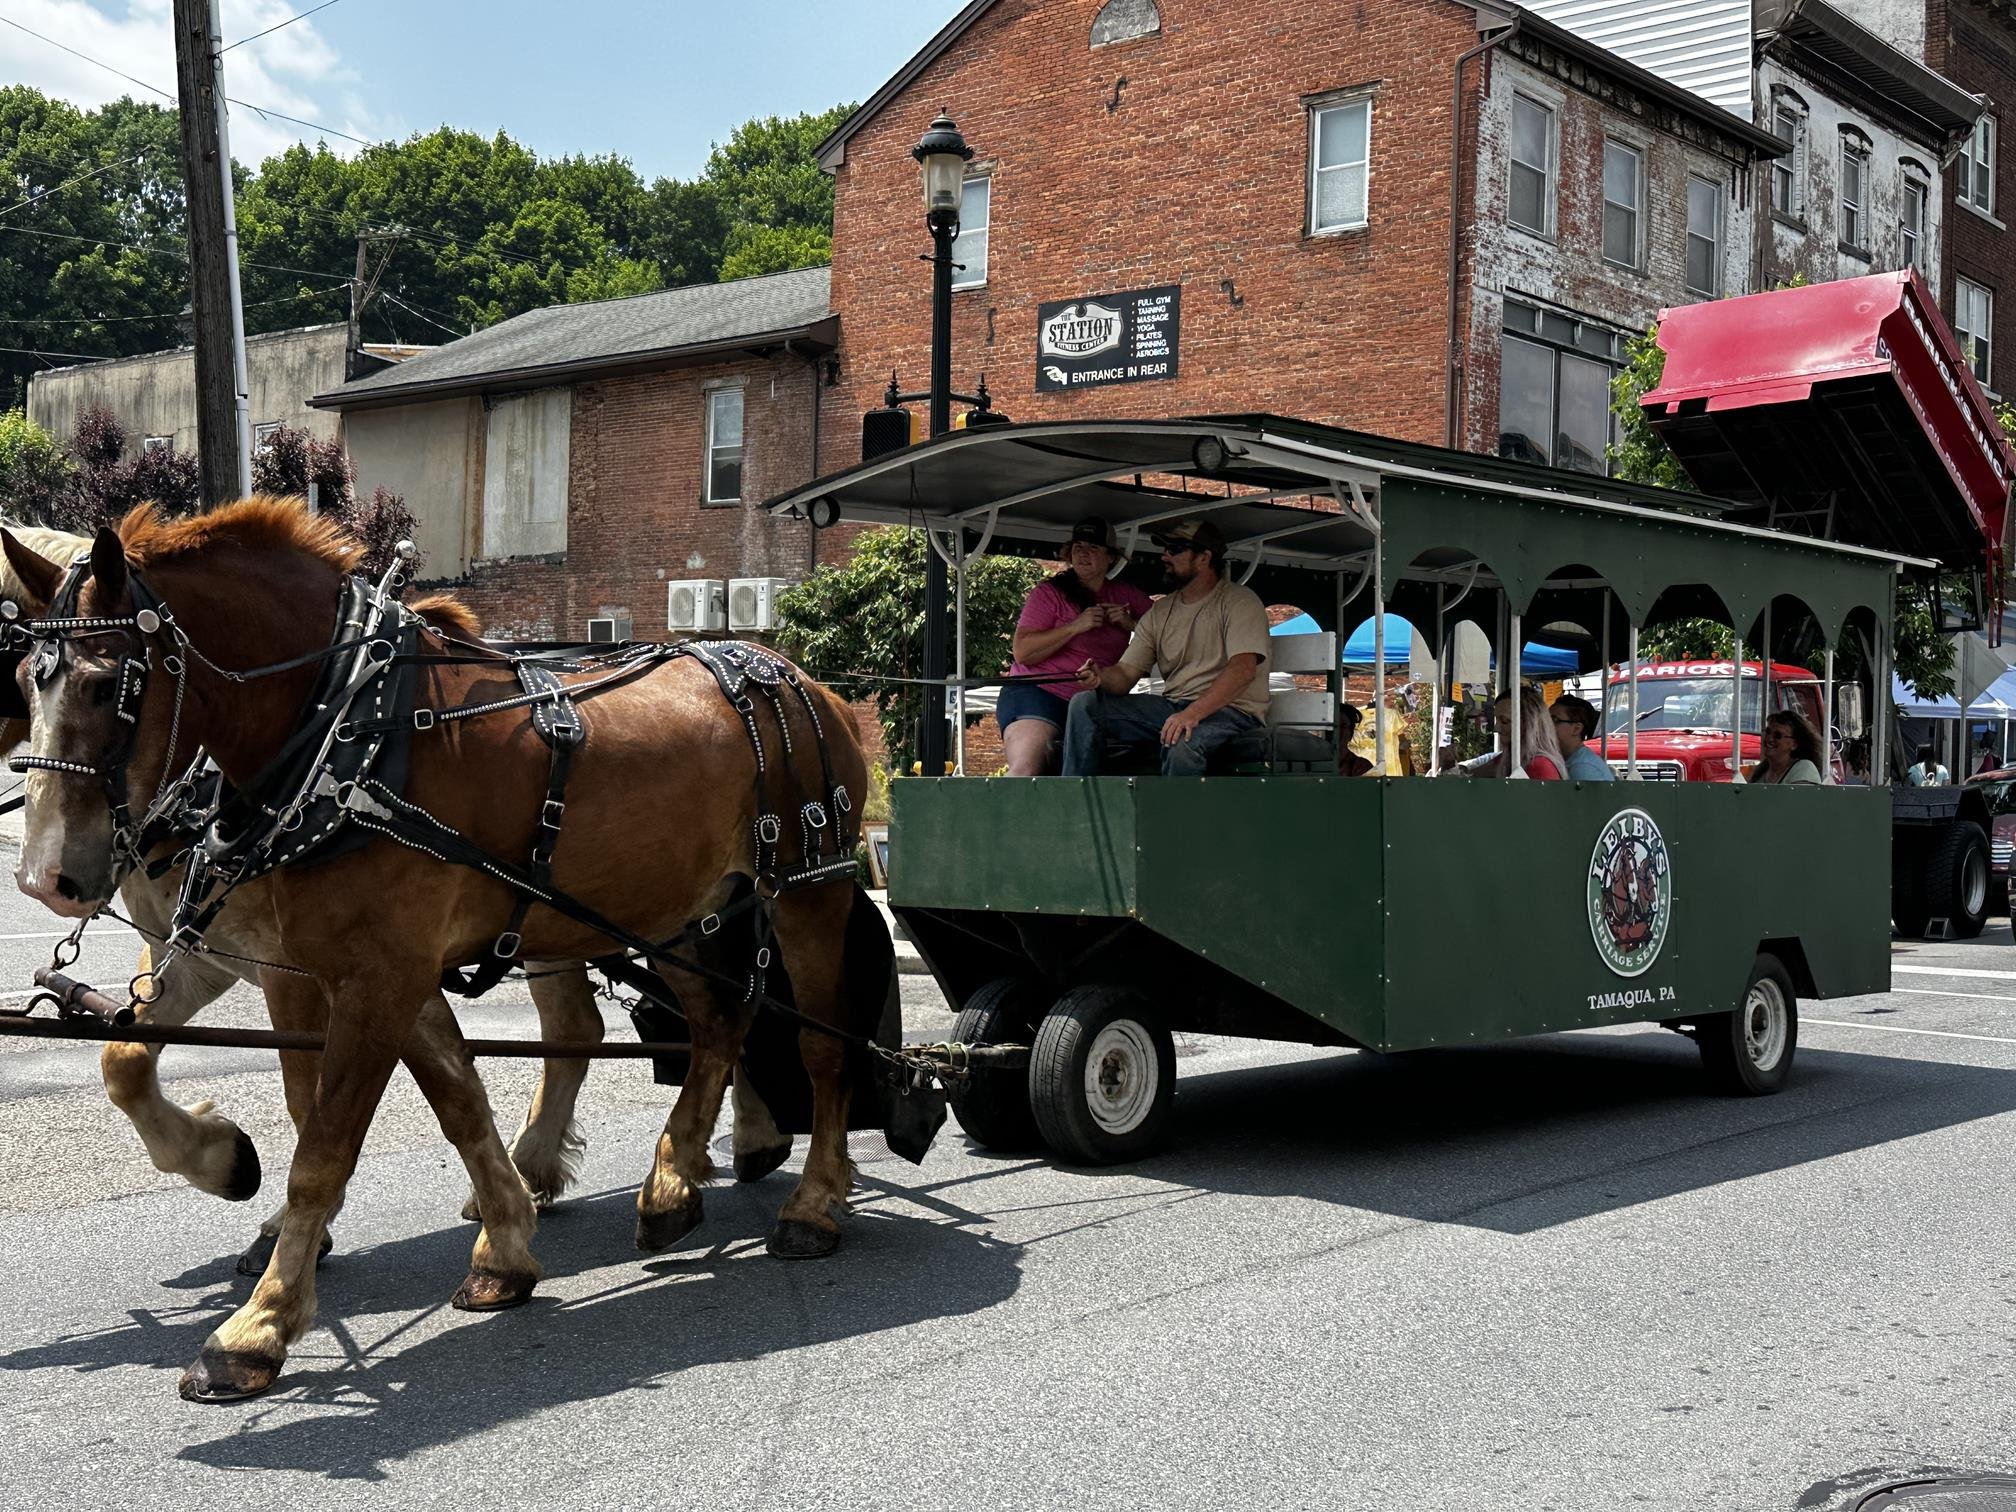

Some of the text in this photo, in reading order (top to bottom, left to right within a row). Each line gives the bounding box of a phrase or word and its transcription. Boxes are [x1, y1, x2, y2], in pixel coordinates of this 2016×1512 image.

[1137, 295, 1172, 307] FULL GYM
[1137, 305, 1166, 315] TANNING
[1060, 313, 1072, 322] THE
[1136, 313, 1169, 324] MASSAGE
[1048, 317, 1114, 343] STATION
[1136, 324, 1156, 332] YOGA
[1135, 331, 1163, 341] PILATES
[1056, 336, 1108, 352] FITNESS CENTER
[1135, 339, 1167, 350] SPINNING
[1135, 347, 1170, 359] AEROBICS
[1072, 363, 1168, 383] ENTRANCE IN REAR
[1978, 430, 2006, 487] INC.
[1592, 816, 1667, 888] LEIBY'S
[1593, 892, 1667, 967] CARRIAGE SERVICE
[1587, 985, 1676, 1009] TAMAQUA, PA
